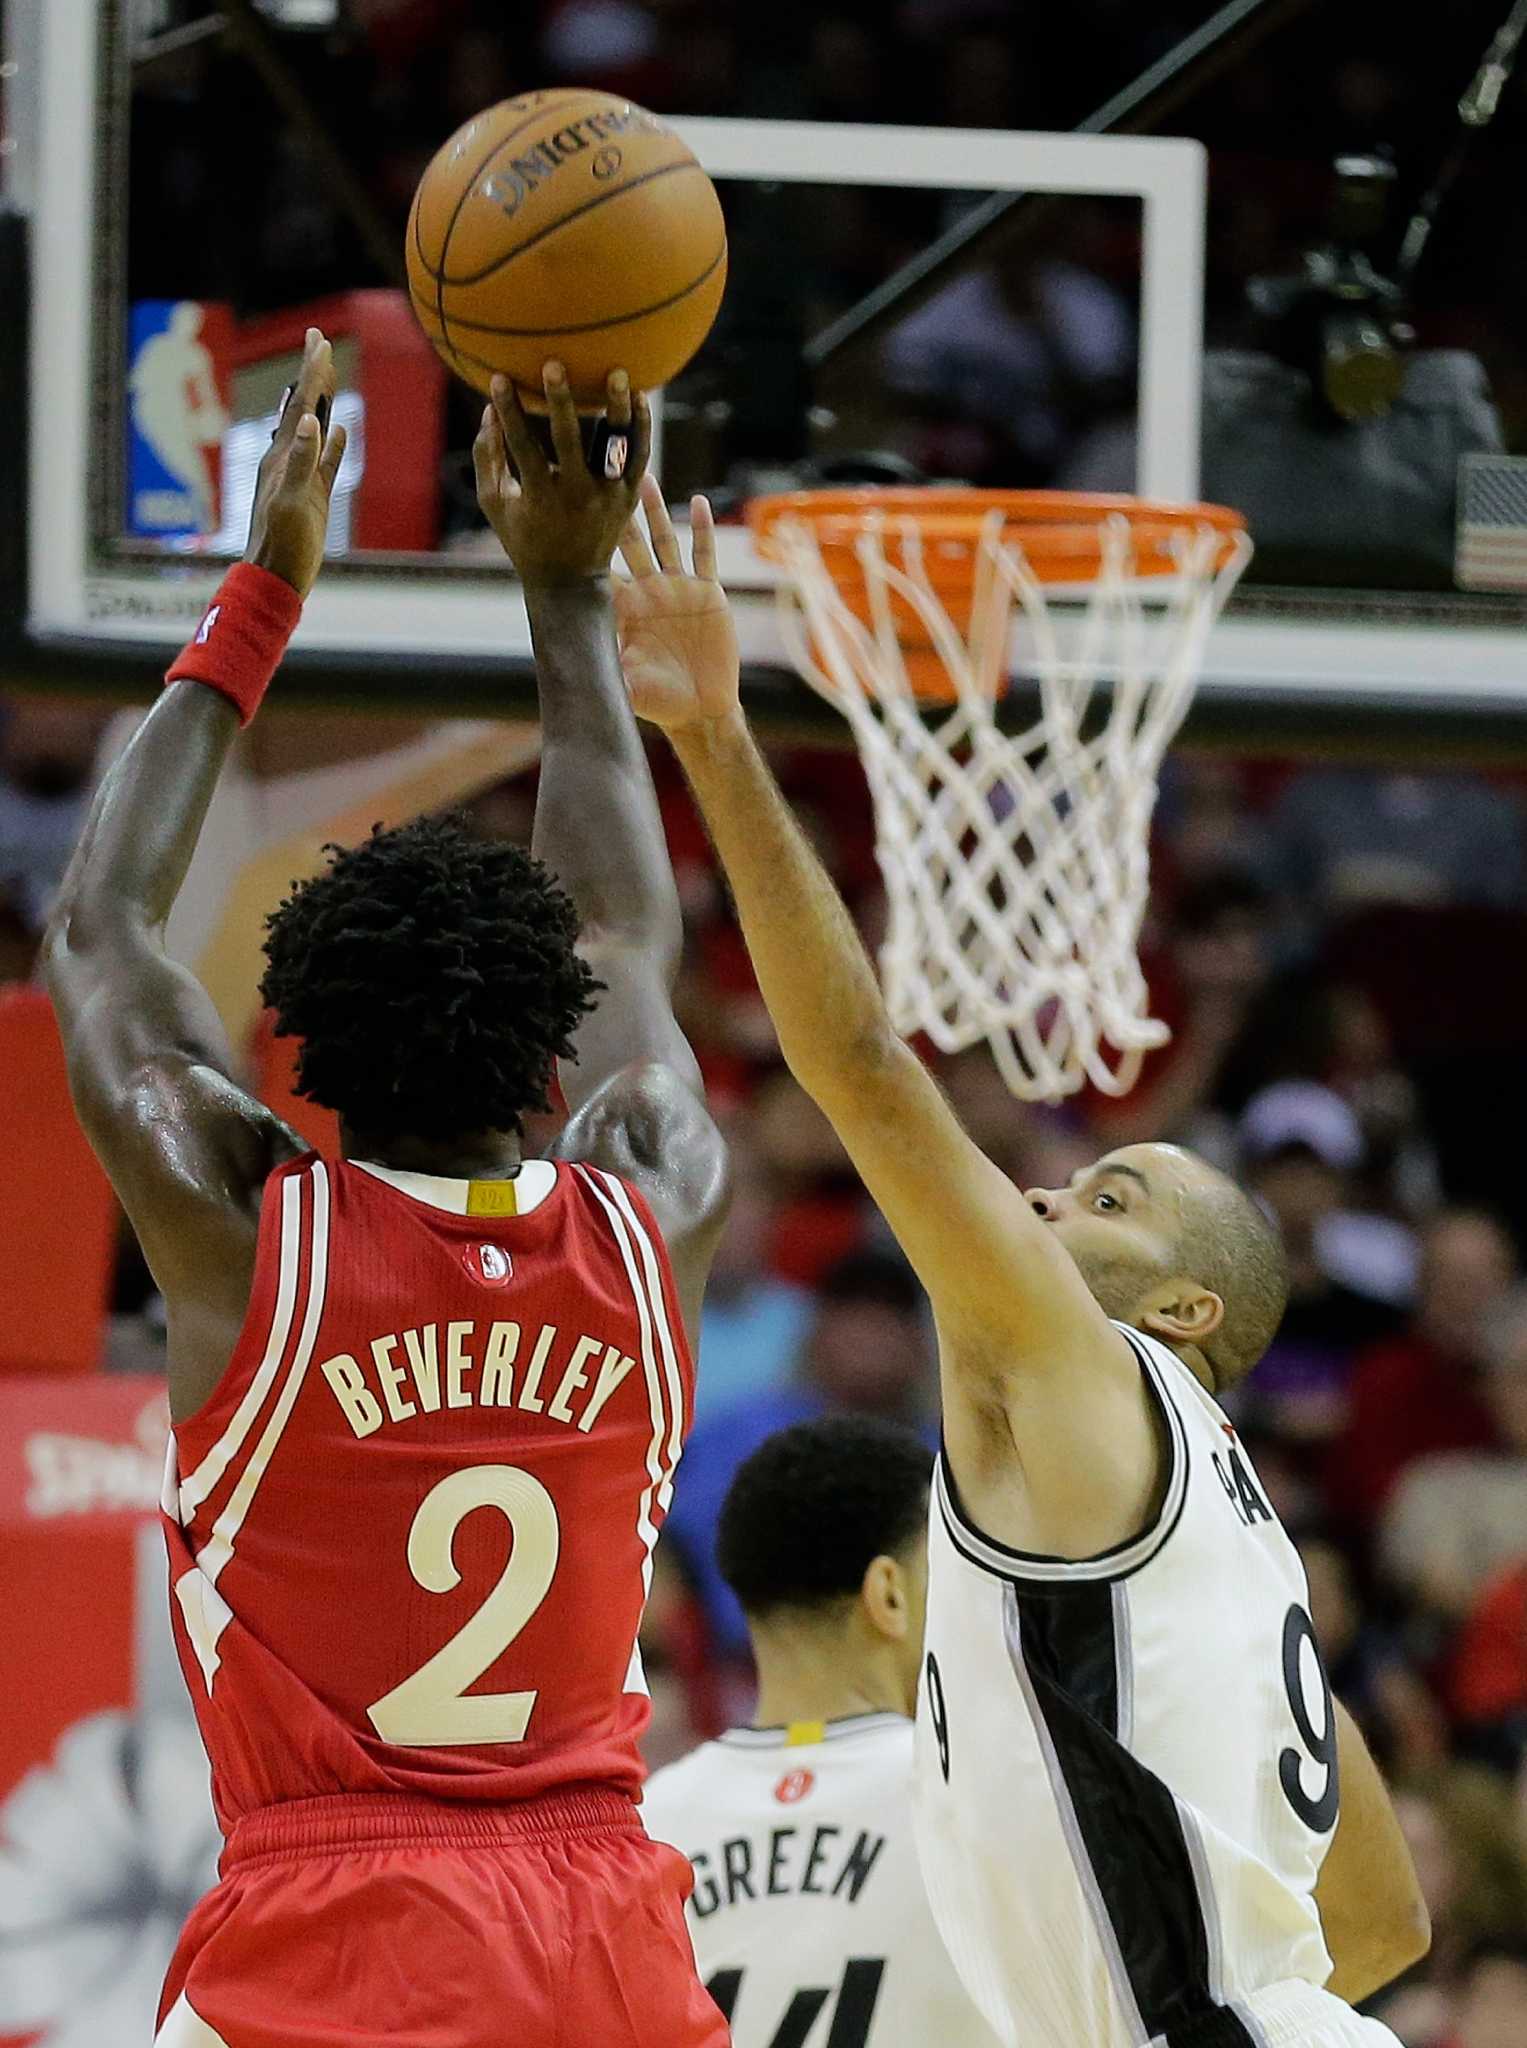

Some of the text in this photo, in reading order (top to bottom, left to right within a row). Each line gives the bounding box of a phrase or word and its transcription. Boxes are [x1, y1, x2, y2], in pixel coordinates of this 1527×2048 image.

[320, 1320, 637, 1440] BEVERLEY
[366, 1463, 560, 1746] 2
[1279, 1602, 1340, 1834] 9
[691, 1824, 885, 1918] GREEN
